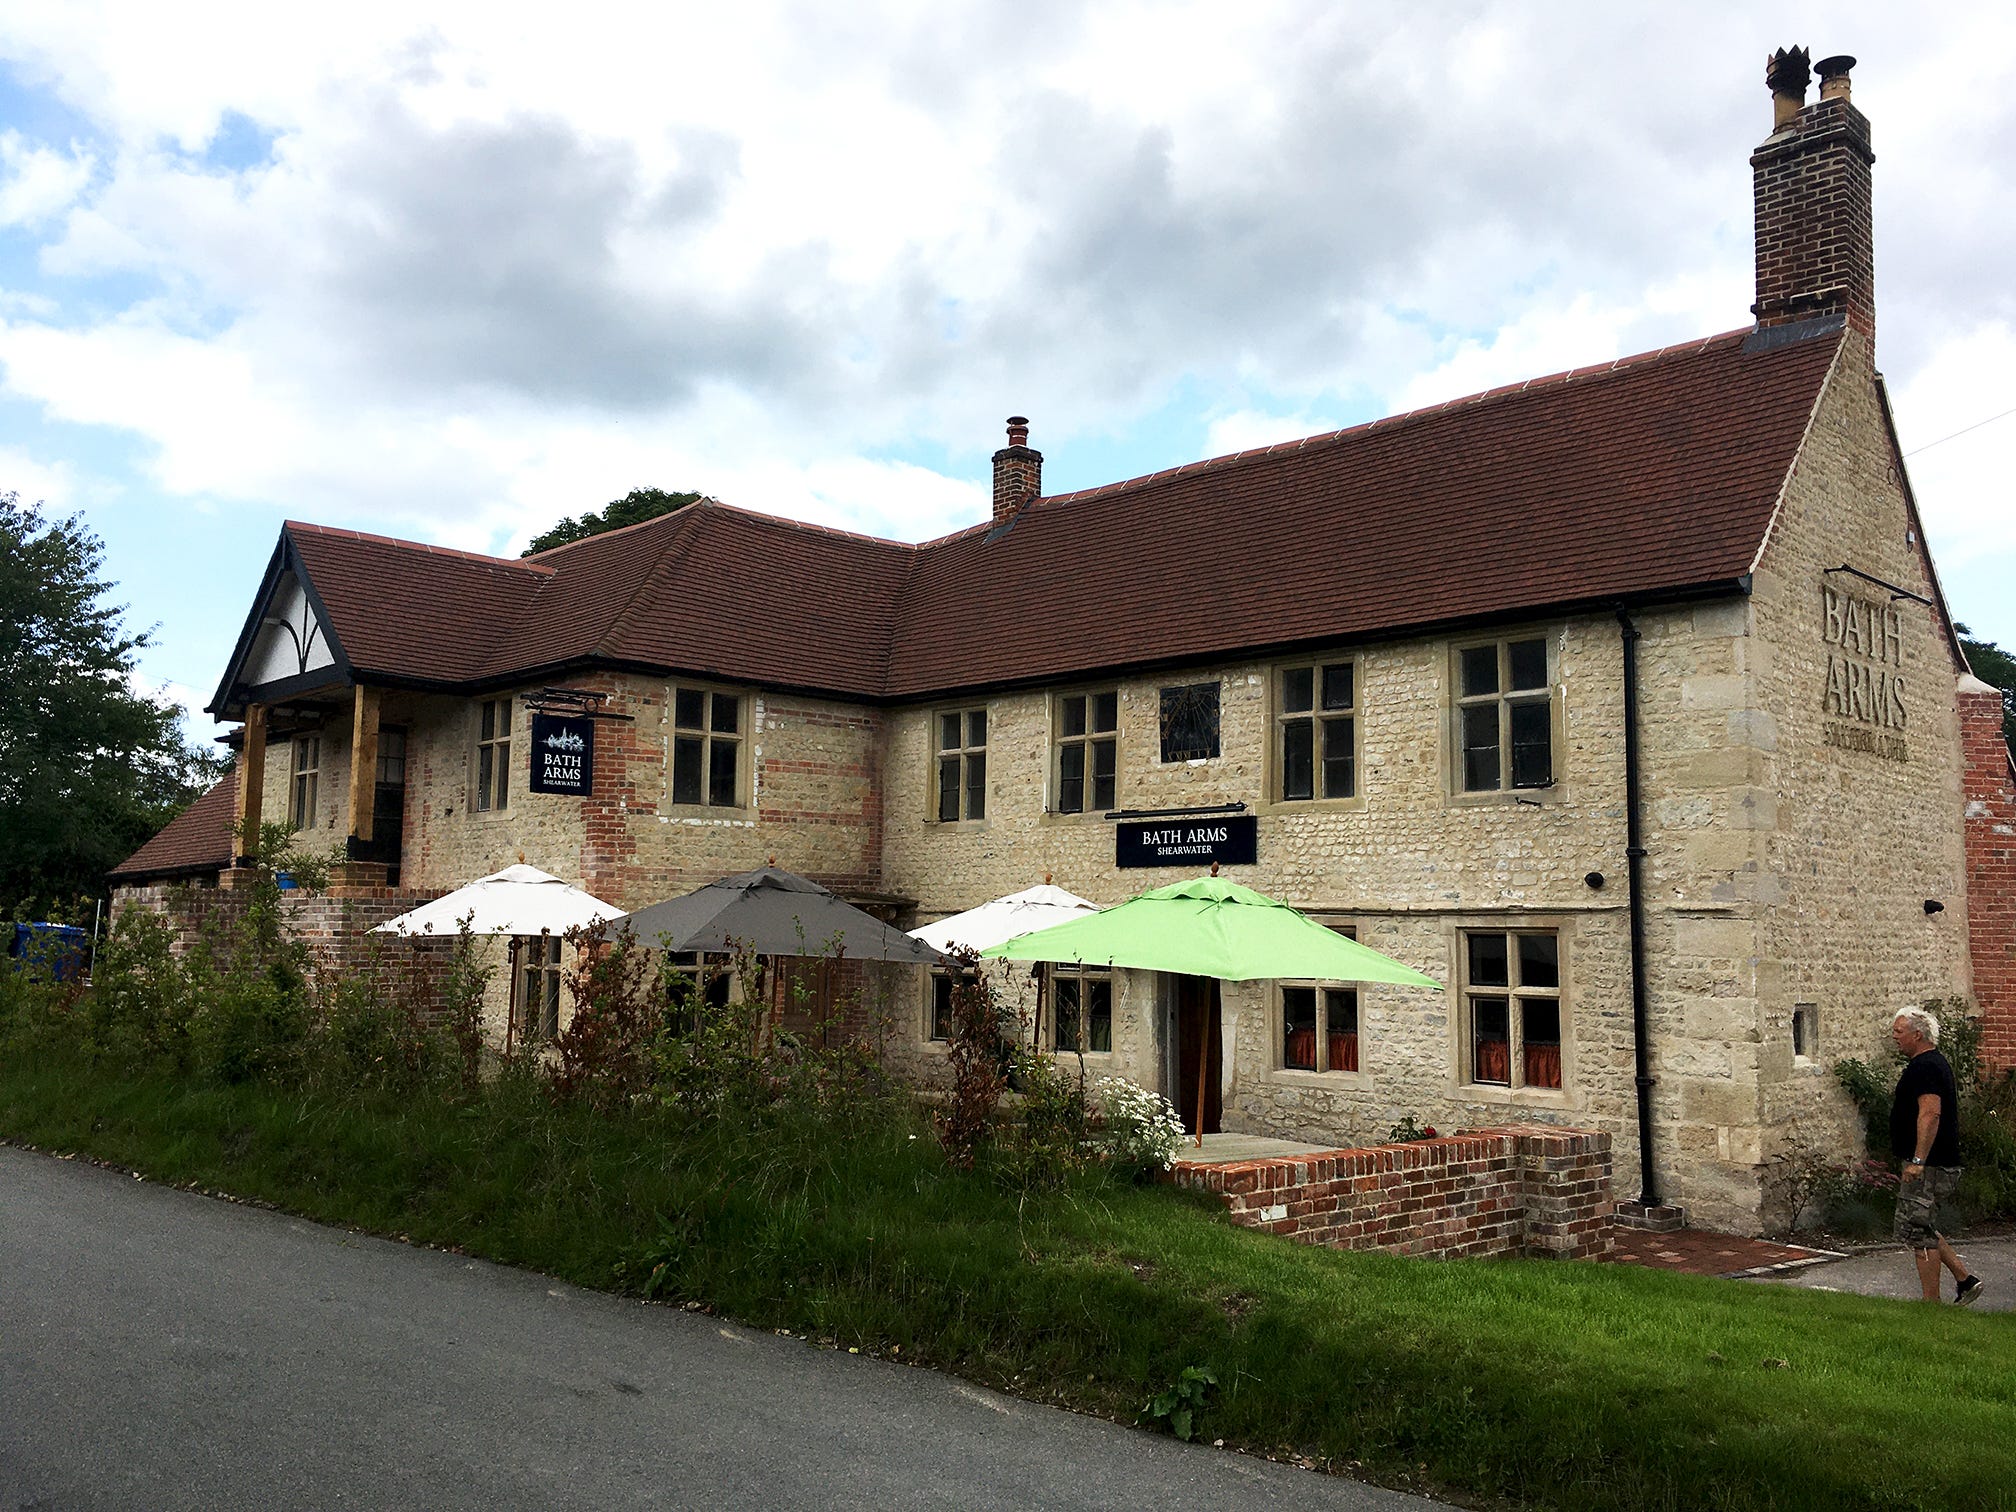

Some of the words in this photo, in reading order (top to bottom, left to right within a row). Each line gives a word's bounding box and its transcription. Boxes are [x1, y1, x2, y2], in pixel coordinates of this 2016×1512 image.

[1822, 584, 1903, 667] BATH
[1822, 654, 1909, 731] ARMS
[544, 753, 581, 767] BATH
[543, 766, 581, 780] ARMS
[543, 779, 581, 787] SHEARWATER
[1142, 829, 1182, 845] BATH
[1186, 826, 1228, 843] ARMS
[1157, 845, 1213, 856] SHEARWATER
